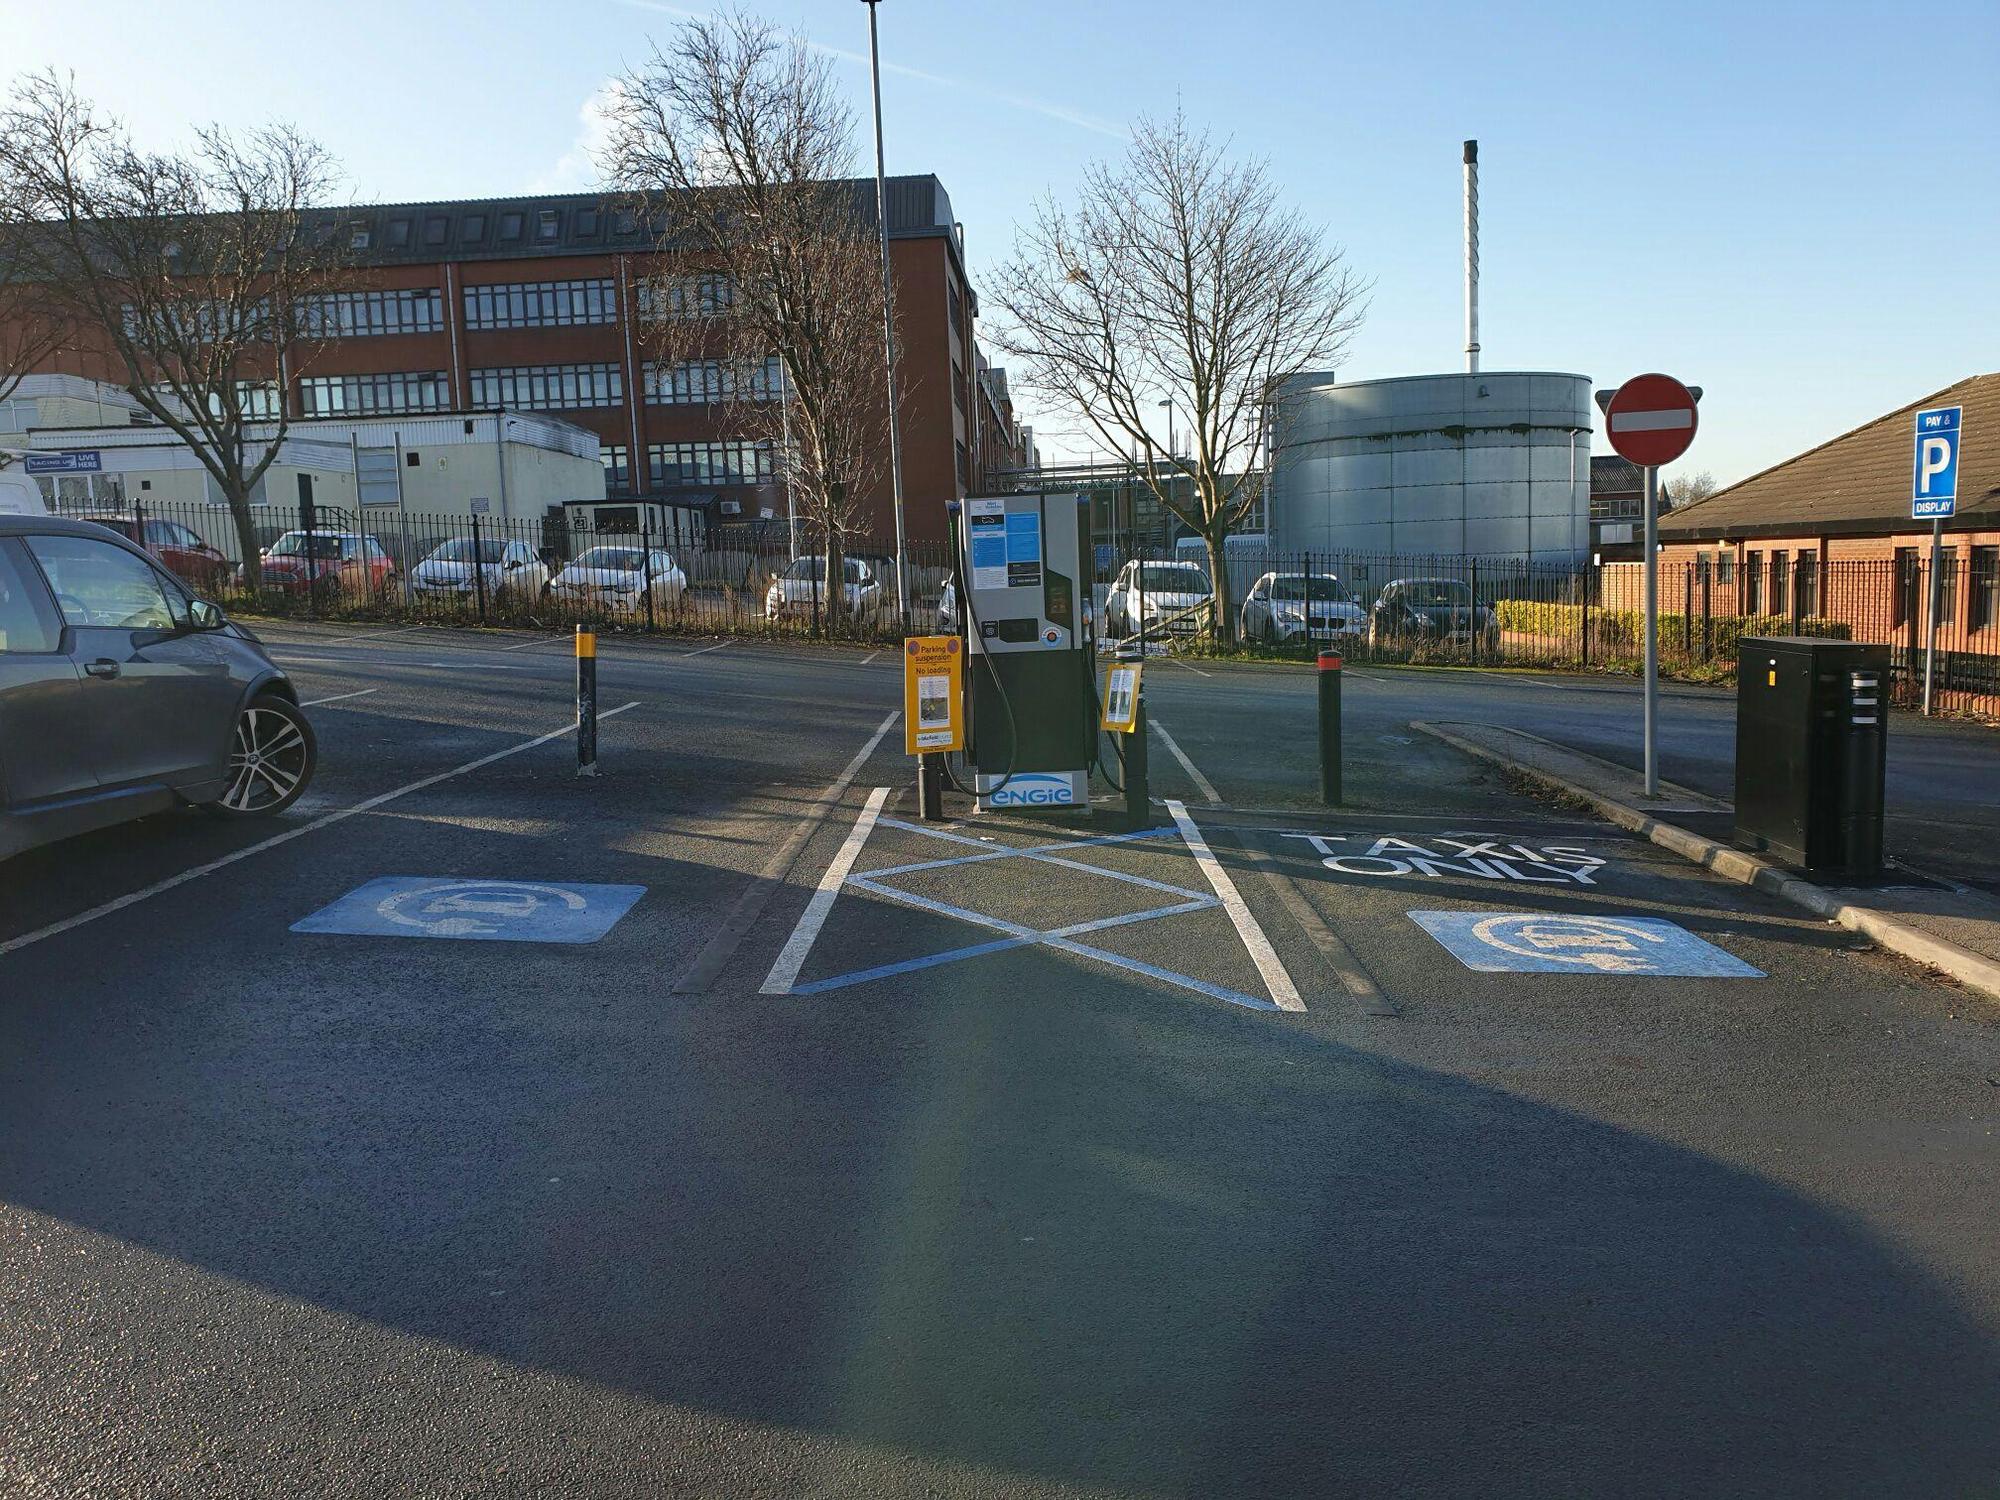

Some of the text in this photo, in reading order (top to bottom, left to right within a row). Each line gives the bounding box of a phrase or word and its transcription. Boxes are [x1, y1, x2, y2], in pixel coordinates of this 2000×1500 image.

[1925, 414, 1951, 427] PAY &
[1921, 437, 1951, 493] P
[1916, 501, 1952, 513] DISPLAY
[921, 646, 946, 654] Parking
[915, 654, 952, 663] suspension
[927, 666, 952, 675] loading
[1279, 833, 1607, 866] TAXIS
[1322, 855, 1601, 885] ONLY
